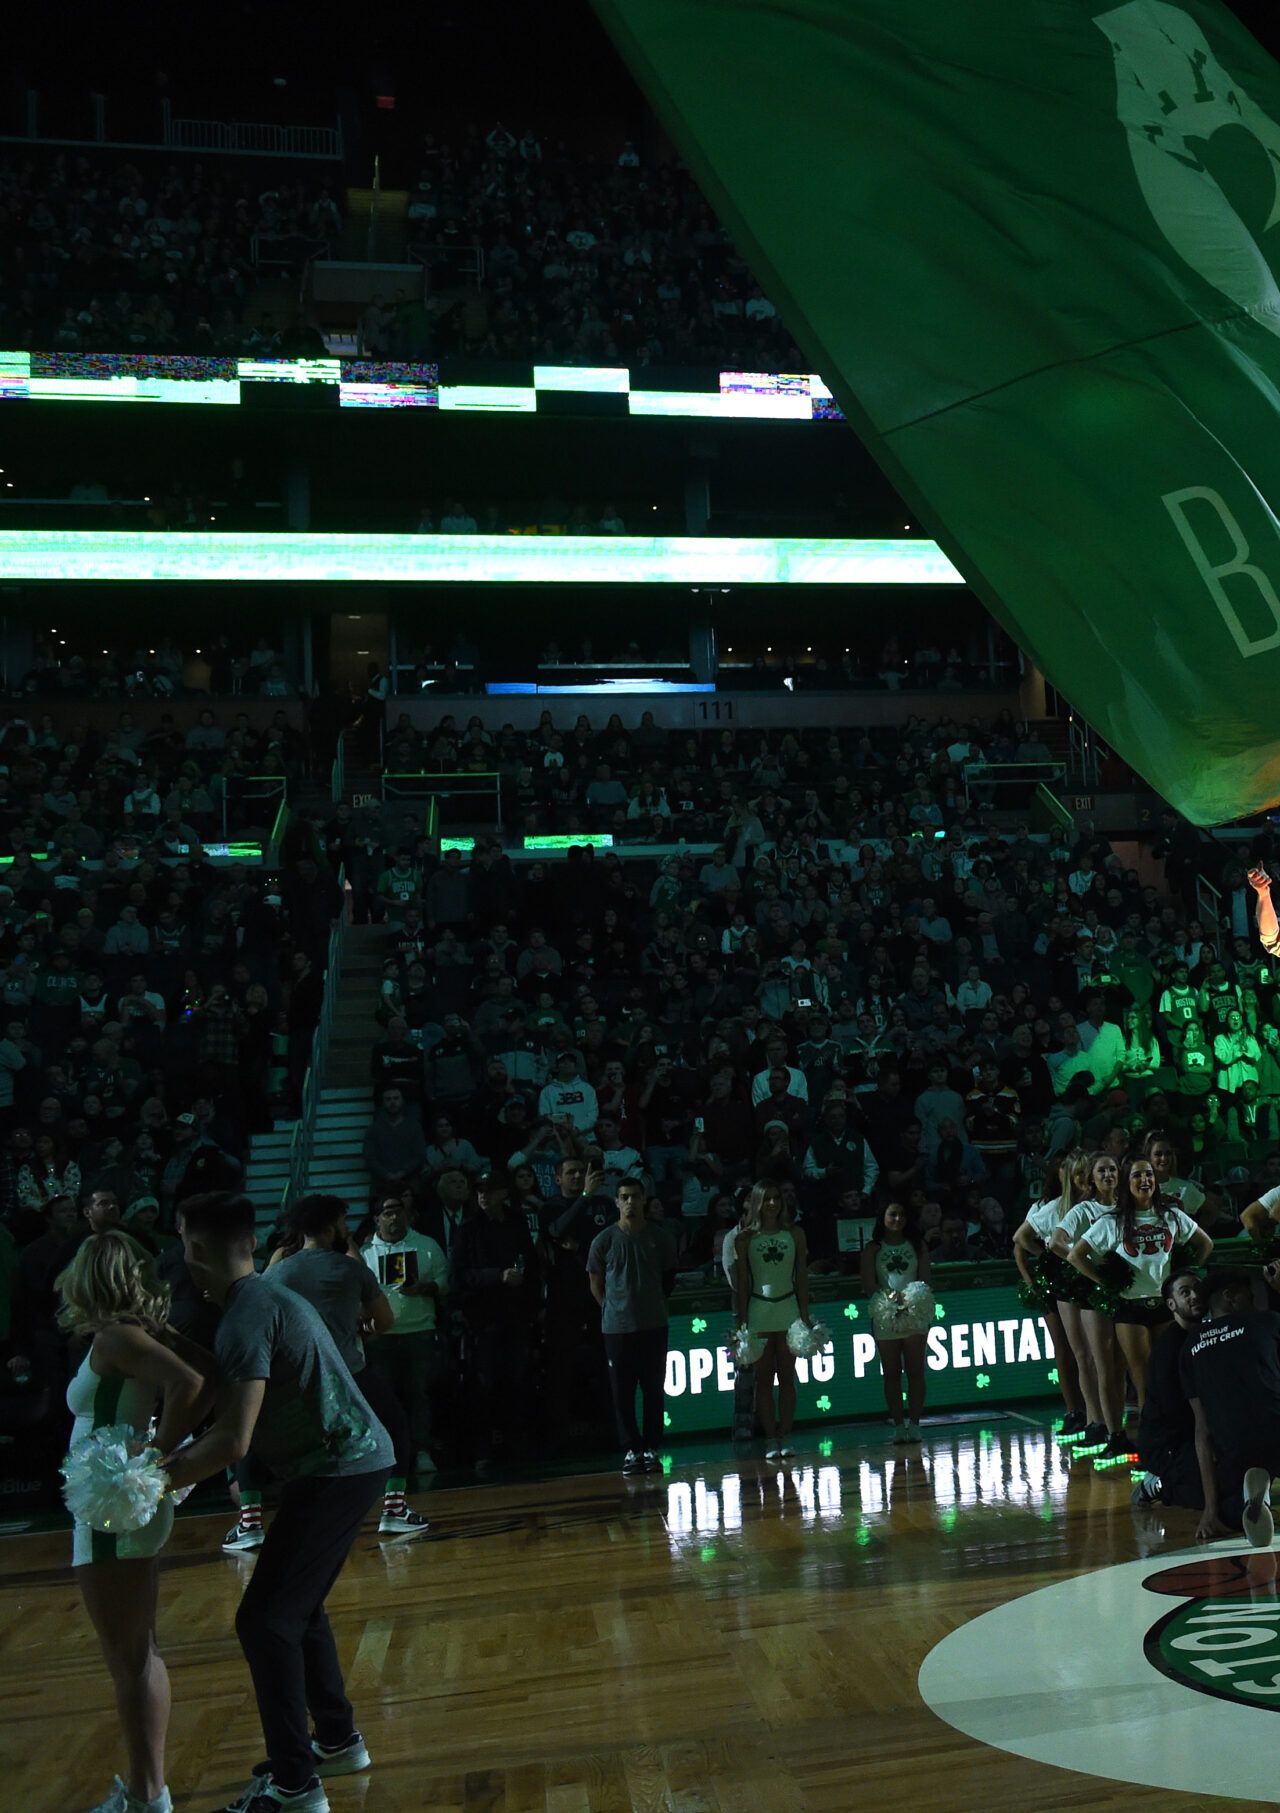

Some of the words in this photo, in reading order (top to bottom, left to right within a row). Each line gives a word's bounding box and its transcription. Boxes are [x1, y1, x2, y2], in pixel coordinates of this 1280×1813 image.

[699, 701, 732, 719] 111
[1074, 797, 1093, 810] EXIT
[1175, 998, 1196, 1008] BOSTON
[1183, 1006, 1193, 1019] 0
[1219, 1326, 1245, 1342] CREW
